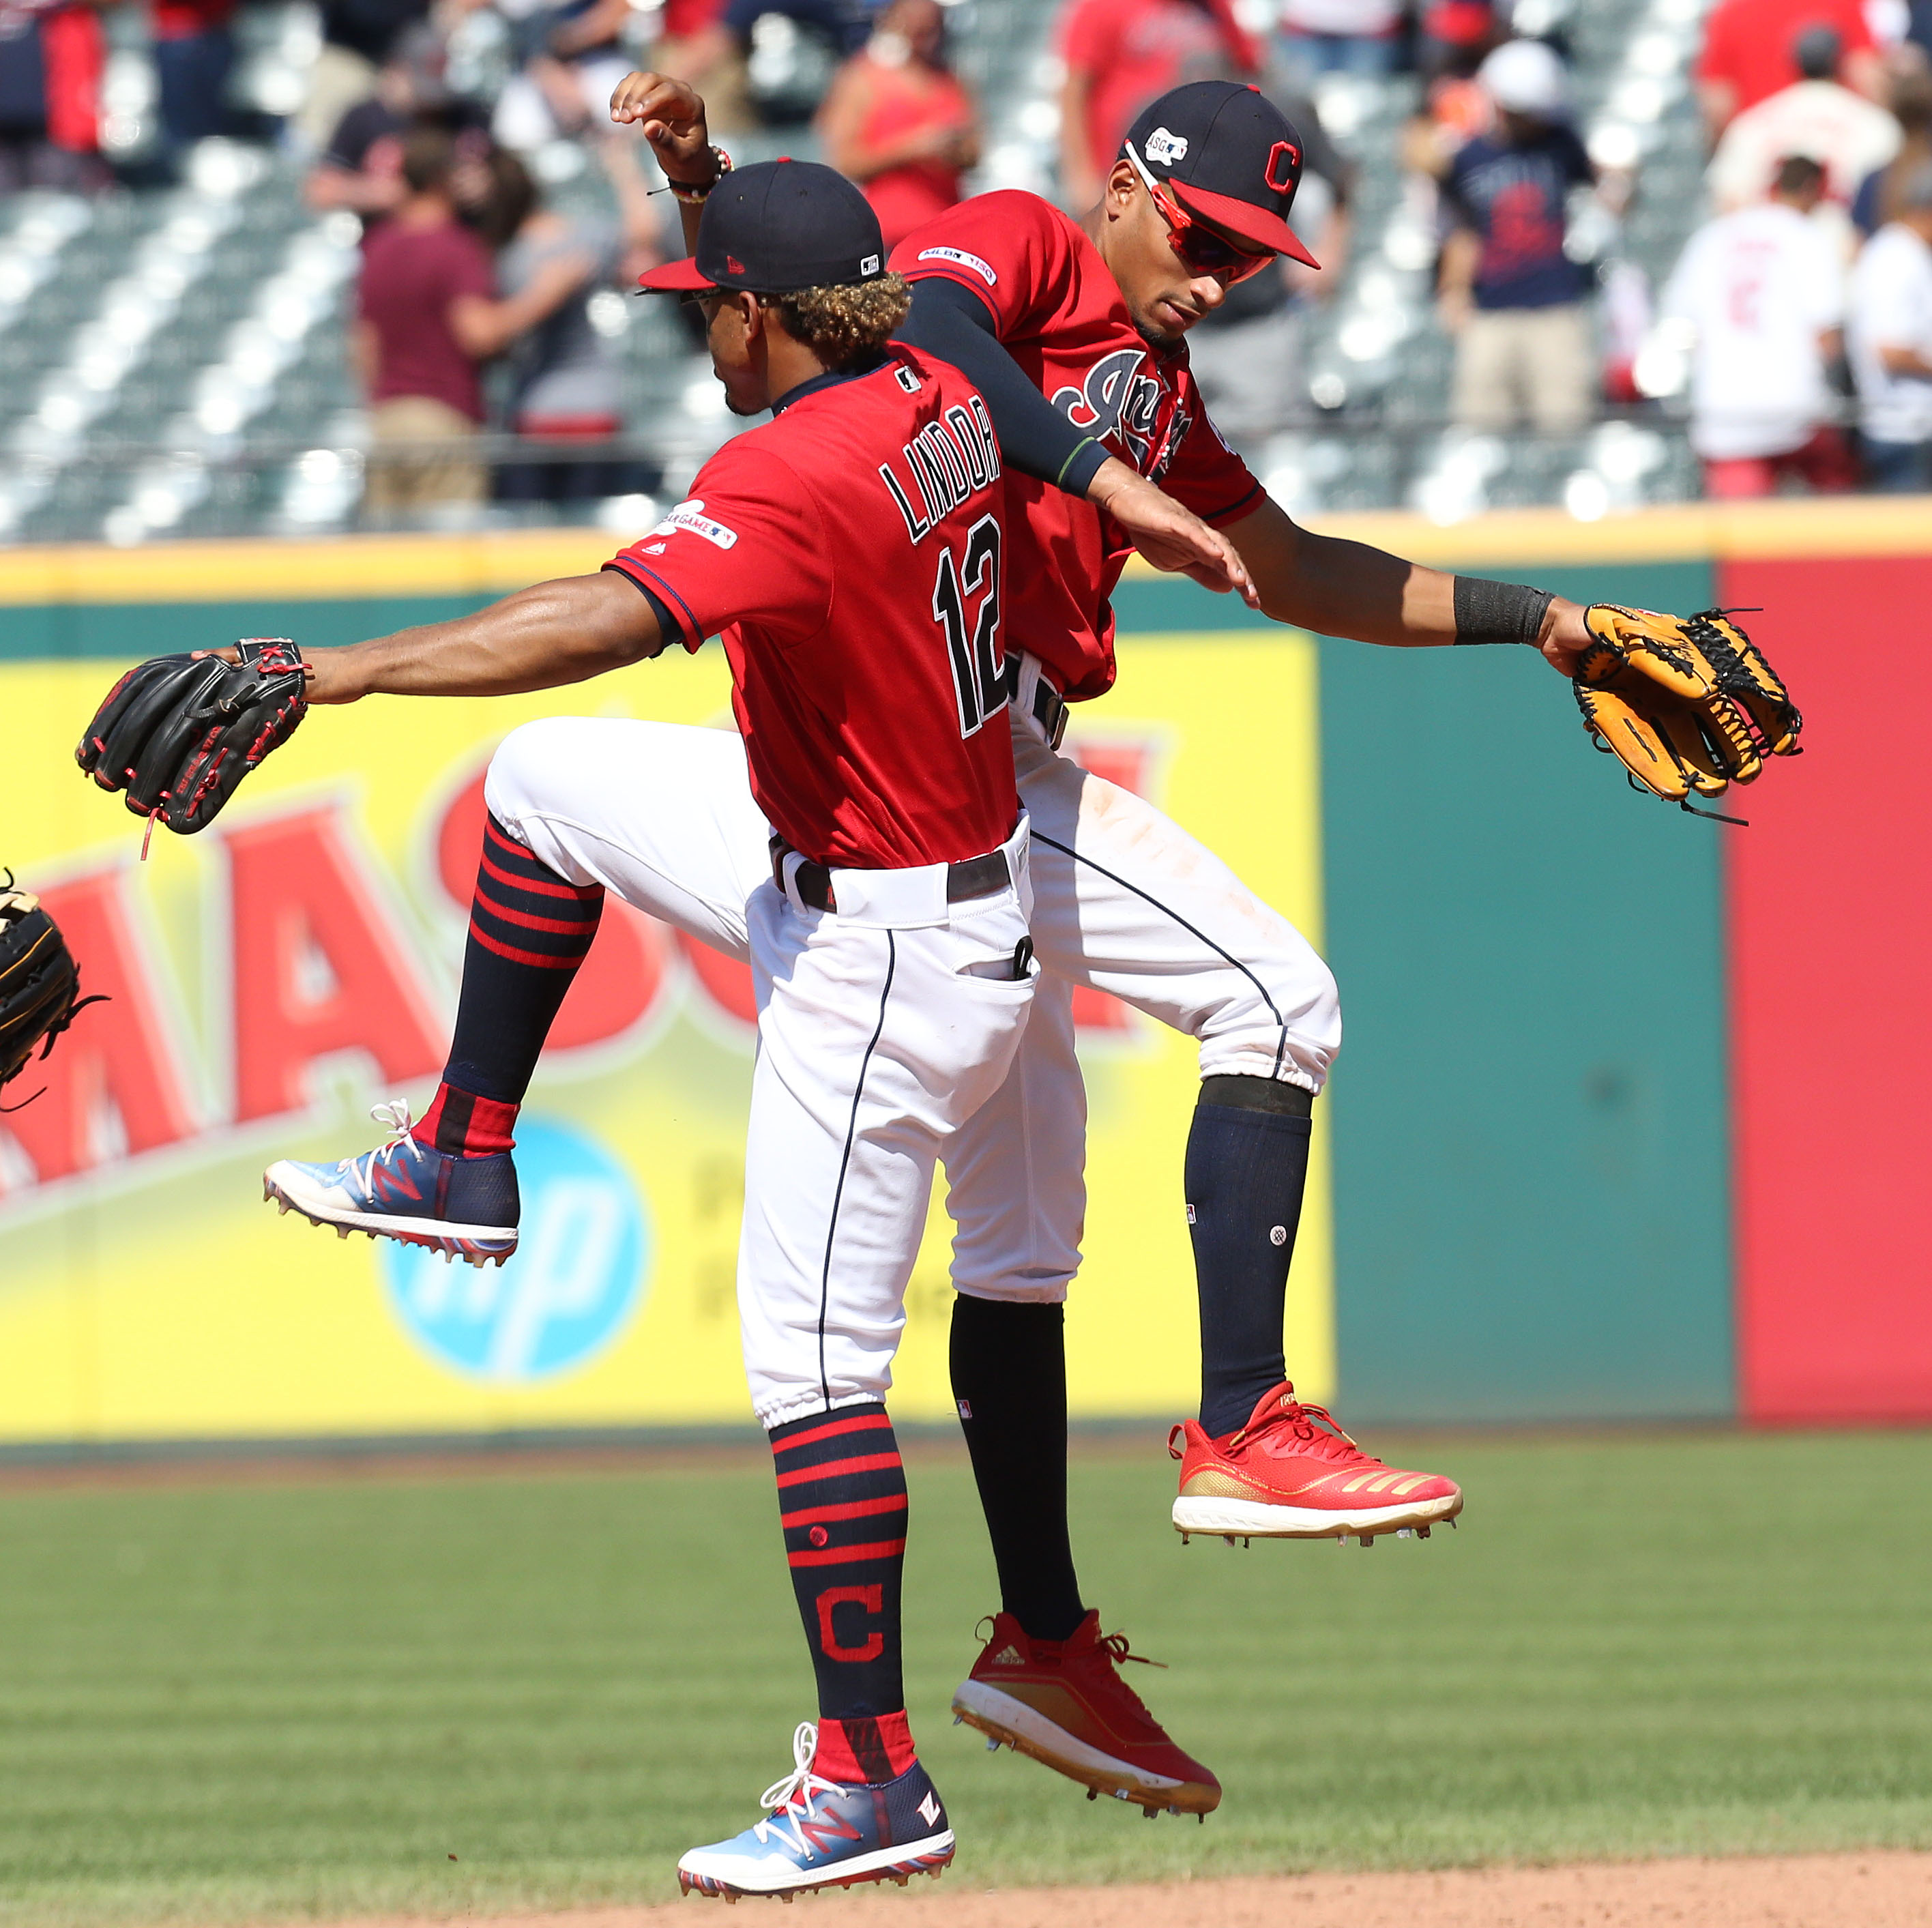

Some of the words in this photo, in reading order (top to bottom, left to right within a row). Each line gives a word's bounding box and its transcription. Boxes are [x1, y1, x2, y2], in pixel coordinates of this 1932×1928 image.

[1264, 140, 1301, 196] C
[678, 514, 712, 532] GAME
[932, 512, 1010, 740] 12
[816, 1583, 883, 1662] C
